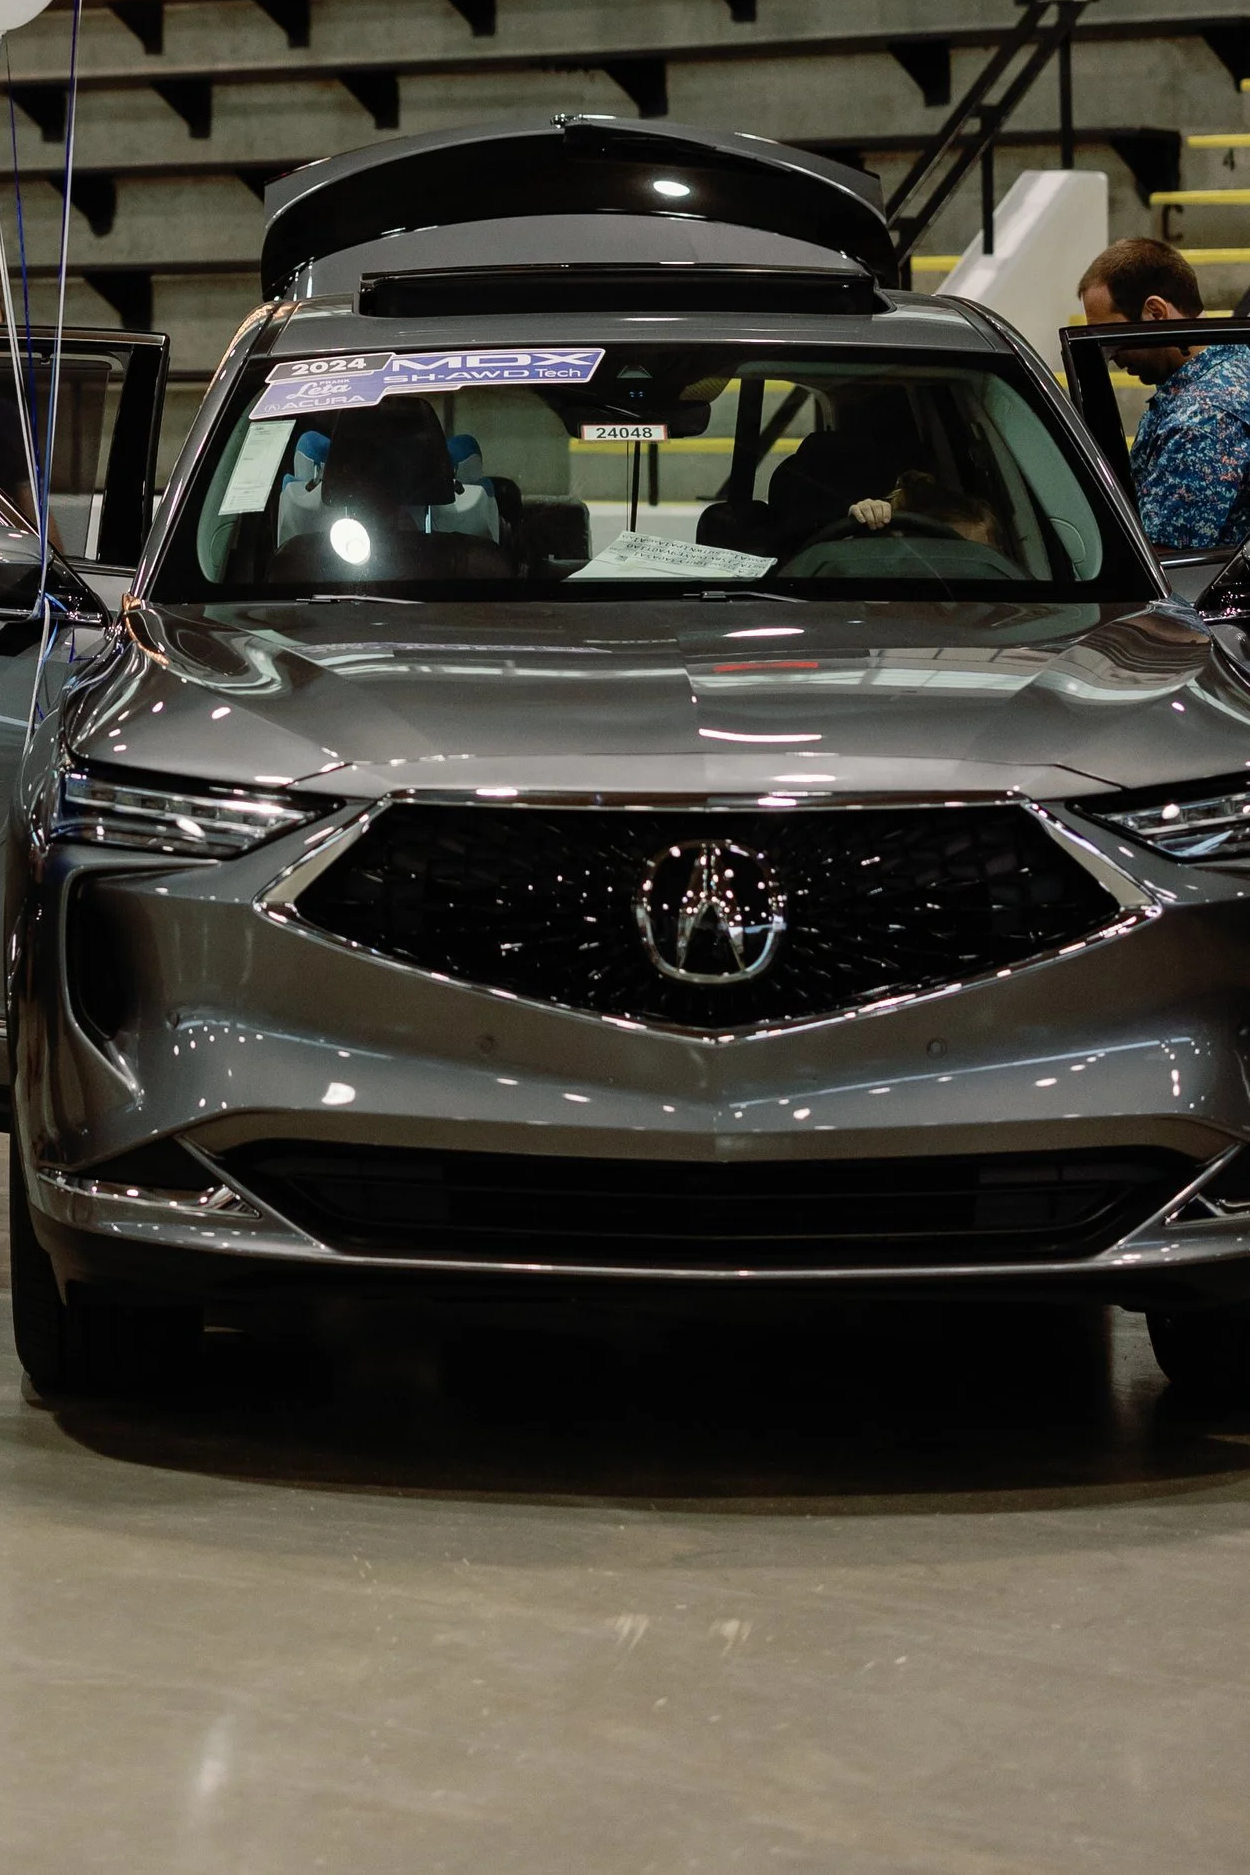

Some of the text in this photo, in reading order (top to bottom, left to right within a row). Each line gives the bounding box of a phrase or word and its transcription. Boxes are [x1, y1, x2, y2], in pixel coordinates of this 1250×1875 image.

[291, 357, 367, 376] 2024
[392, 353, 594, 372] MDX
[318, 378, 350, 386] FRANK
[383, 367, 581, 384] SH-AWD Tech
[285, 381, 353, 400] Leta
[281, 395, 366, 411] ACURA
[595, 427, 653, 439] 24048
